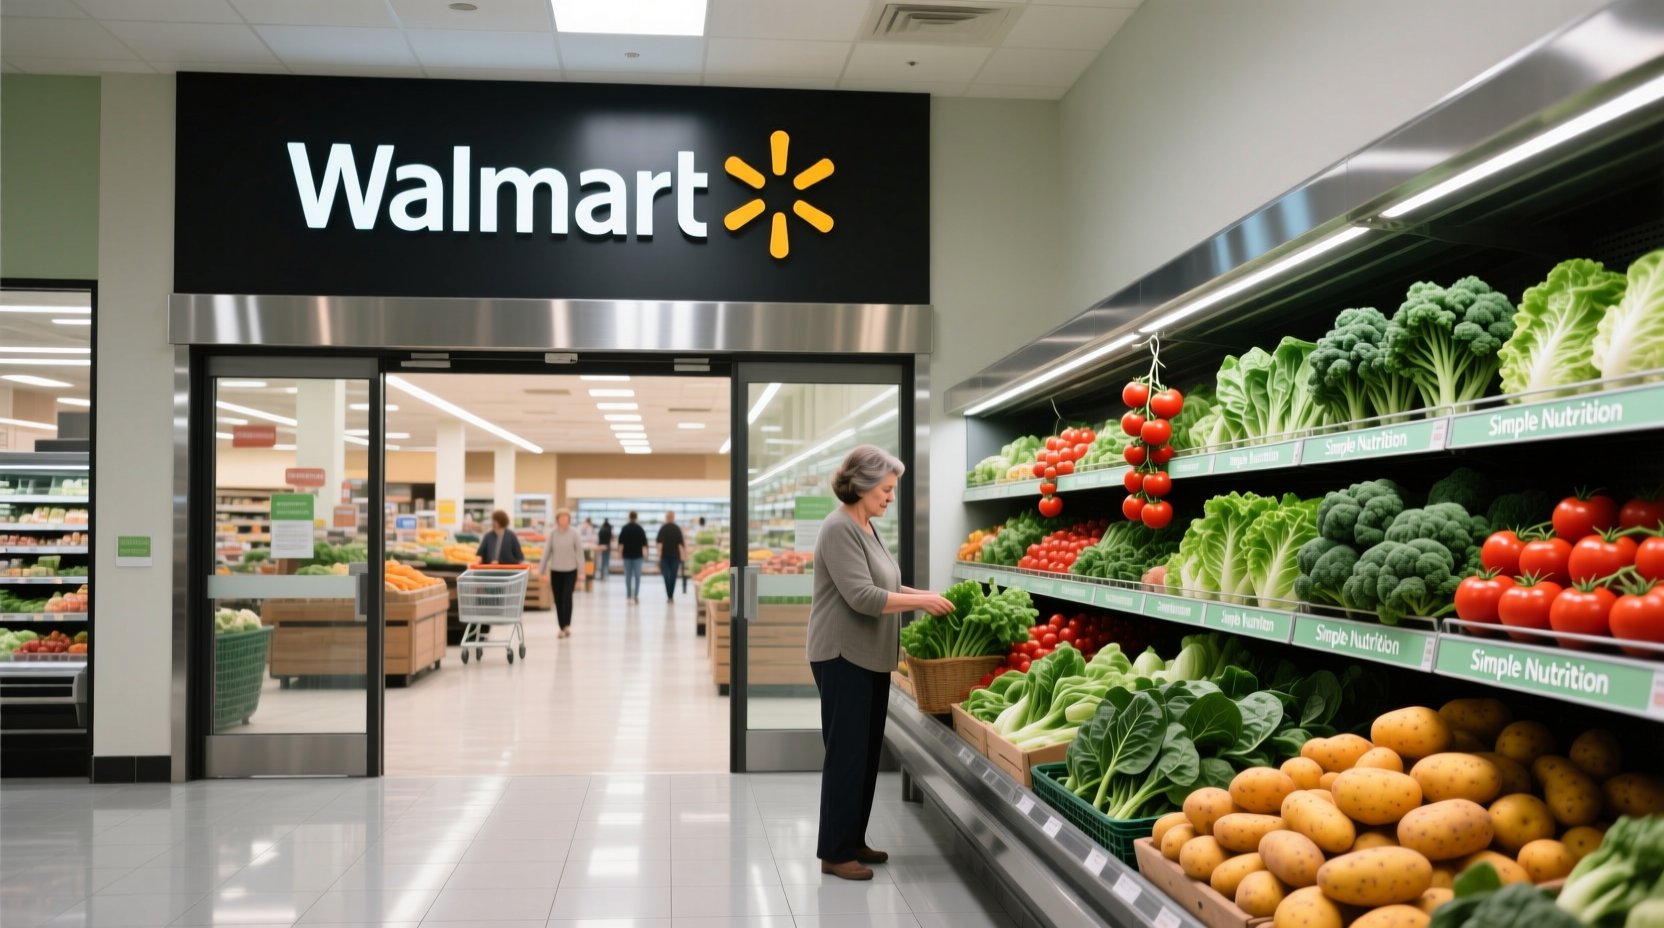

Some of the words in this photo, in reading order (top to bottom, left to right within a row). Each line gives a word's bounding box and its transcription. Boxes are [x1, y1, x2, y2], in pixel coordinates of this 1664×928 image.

[287, 142, 708, 237] Walmart
[1489, 411, 1538, 439] Simple
[1541, 400, 1623, 429] Nutrition
[1470, 649, 1522, 681] Simple
[1525, 657, 1609, 695] Nutrition
